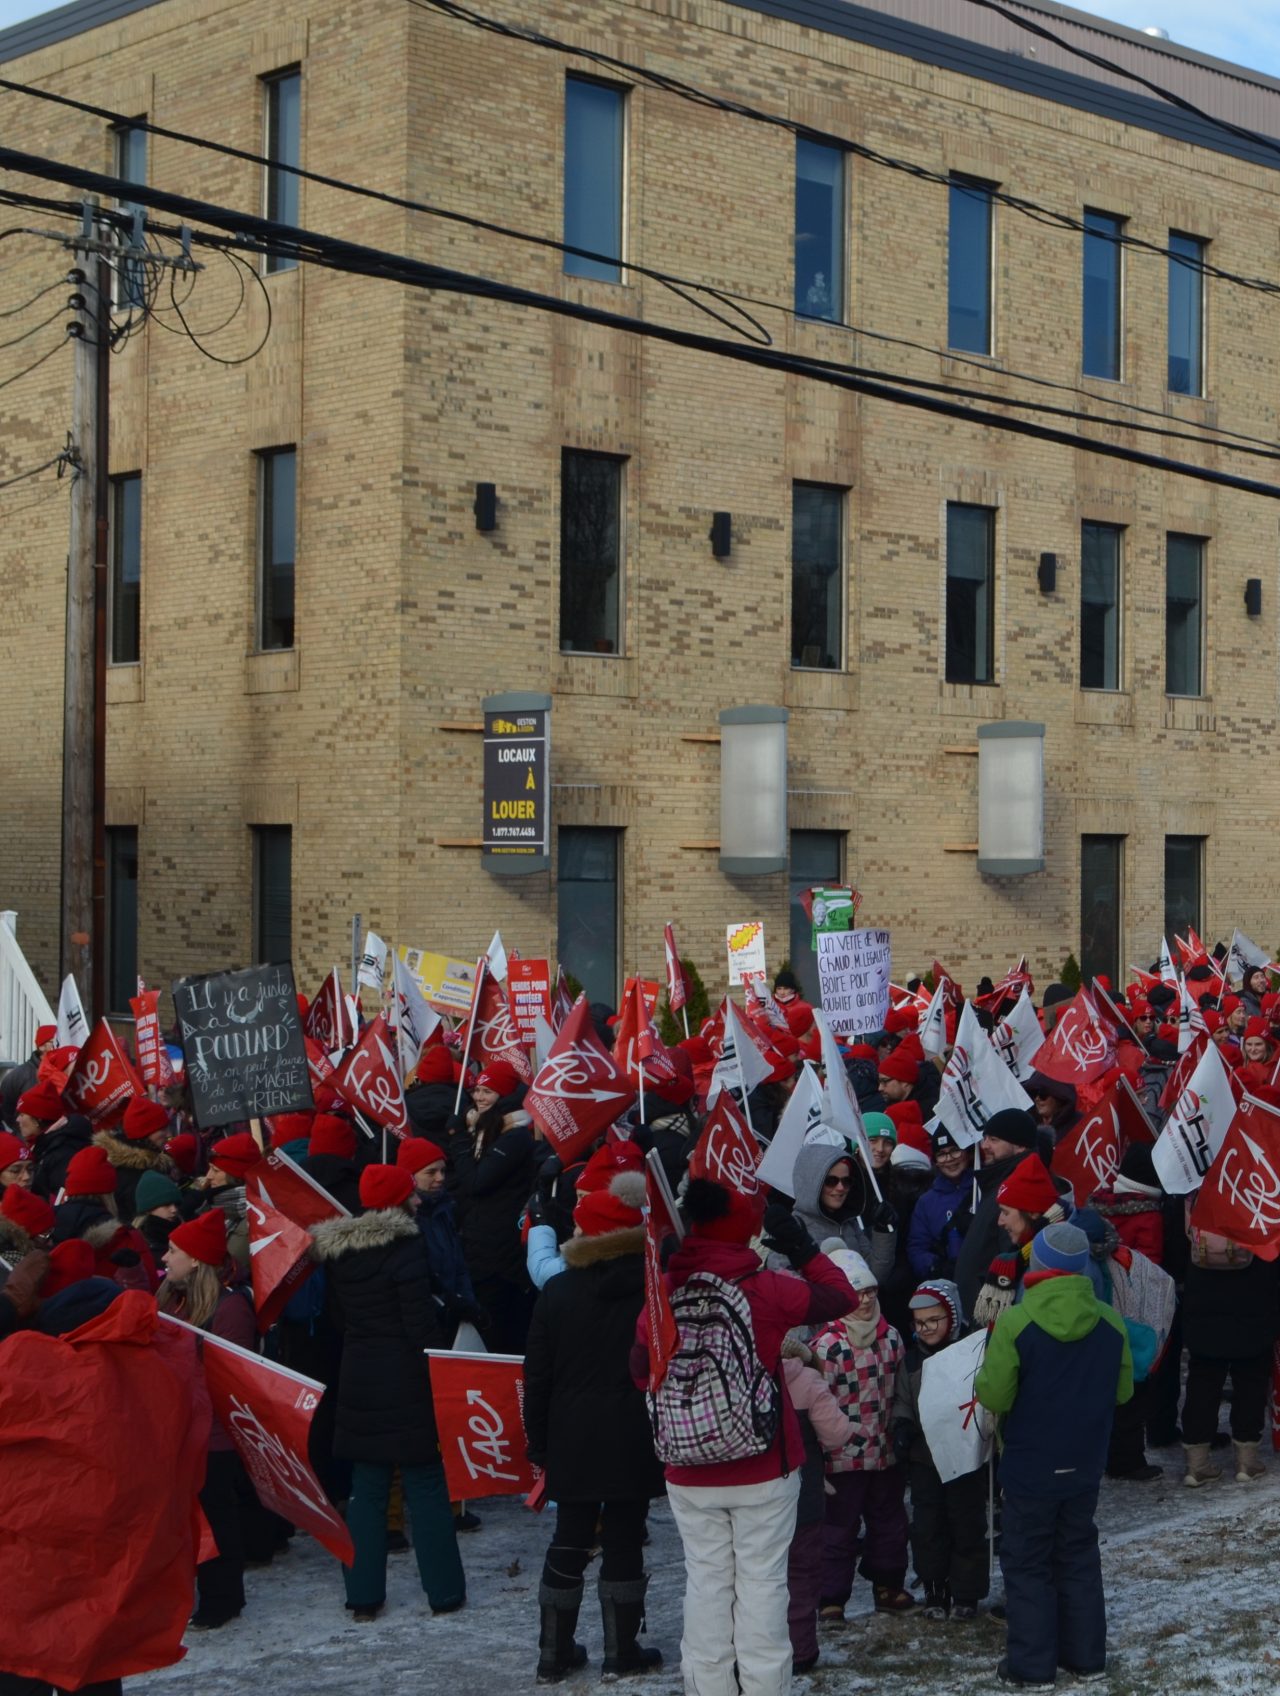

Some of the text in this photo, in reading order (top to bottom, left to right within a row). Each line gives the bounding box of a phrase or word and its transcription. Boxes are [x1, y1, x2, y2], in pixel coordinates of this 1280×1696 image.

[498, 748, 536, 763] LOCAUX
[526, 767, 536, 790] À
[491, 800, 536, 820] LOUER
[184, 981, 216, 1012] Il
[238, 986, 250, 1002] a
[256, 969, 292, 1013] juste
[244, 1055, 269, 1078] peut
[273, 1054, 305, 1077] faire
[210, 1071, 299, 1098] de la MAGIE
[206, 1091, 292, 1115] avec RIEN
